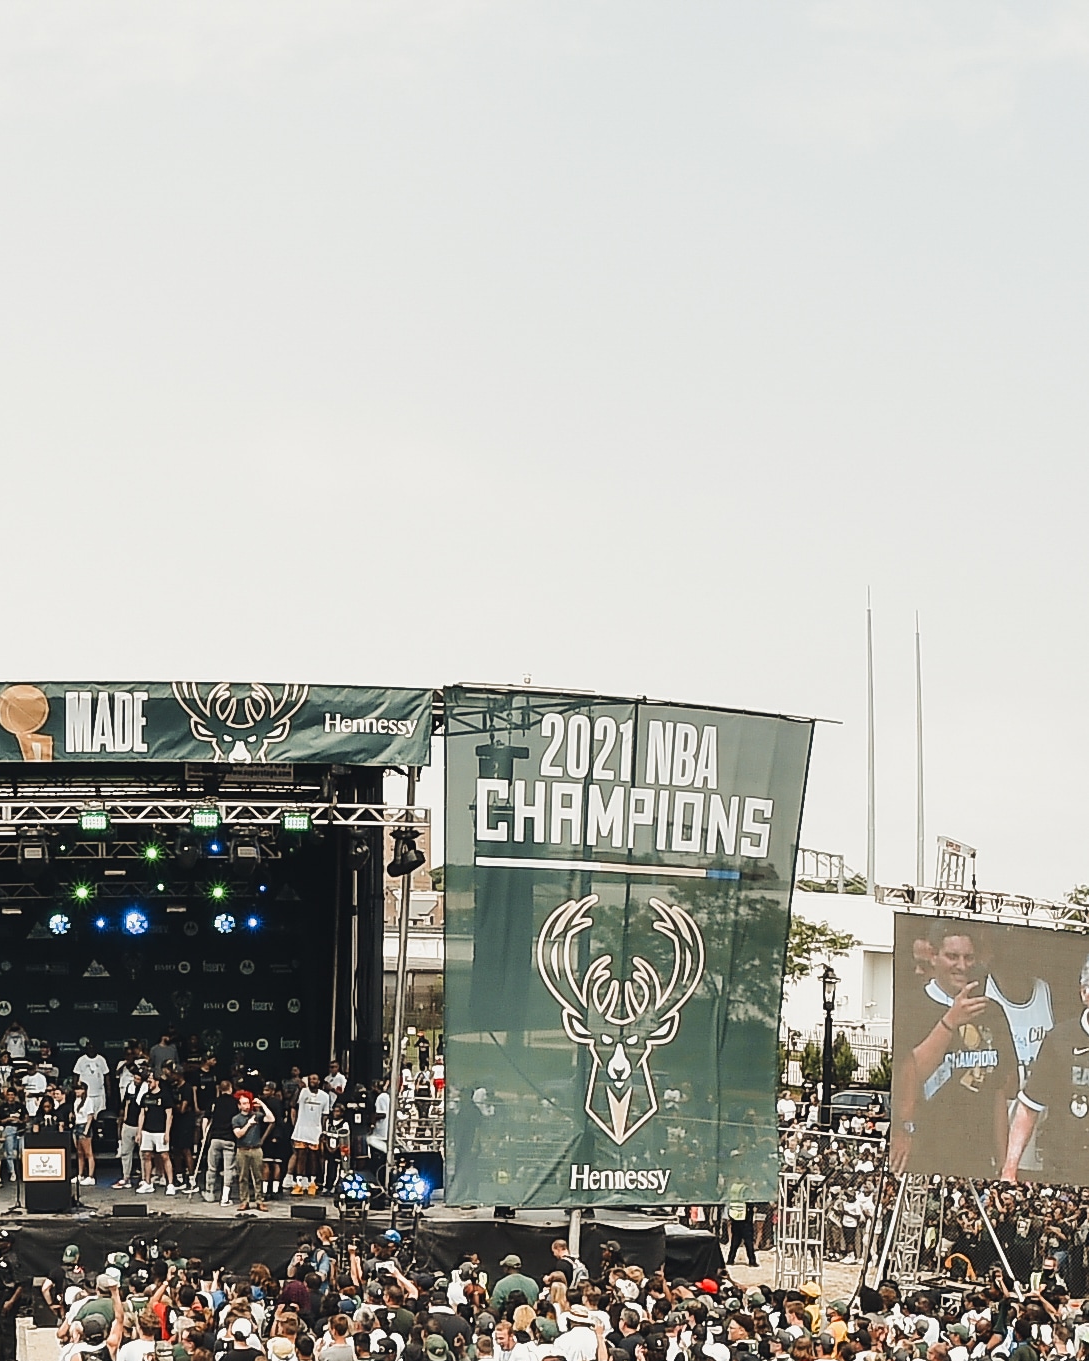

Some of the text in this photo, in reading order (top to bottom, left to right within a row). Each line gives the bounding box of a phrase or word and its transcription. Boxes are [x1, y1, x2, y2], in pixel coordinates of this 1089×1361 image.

[64, 691, 150, 755] MADE
[323, 712, 418, 738] Hennessy
[539, 712, 719, 791] 2021 NBA
[475, 777, 775, 860] CHAMPIONS
[569, 1164, 671, 1195] Hennessy
